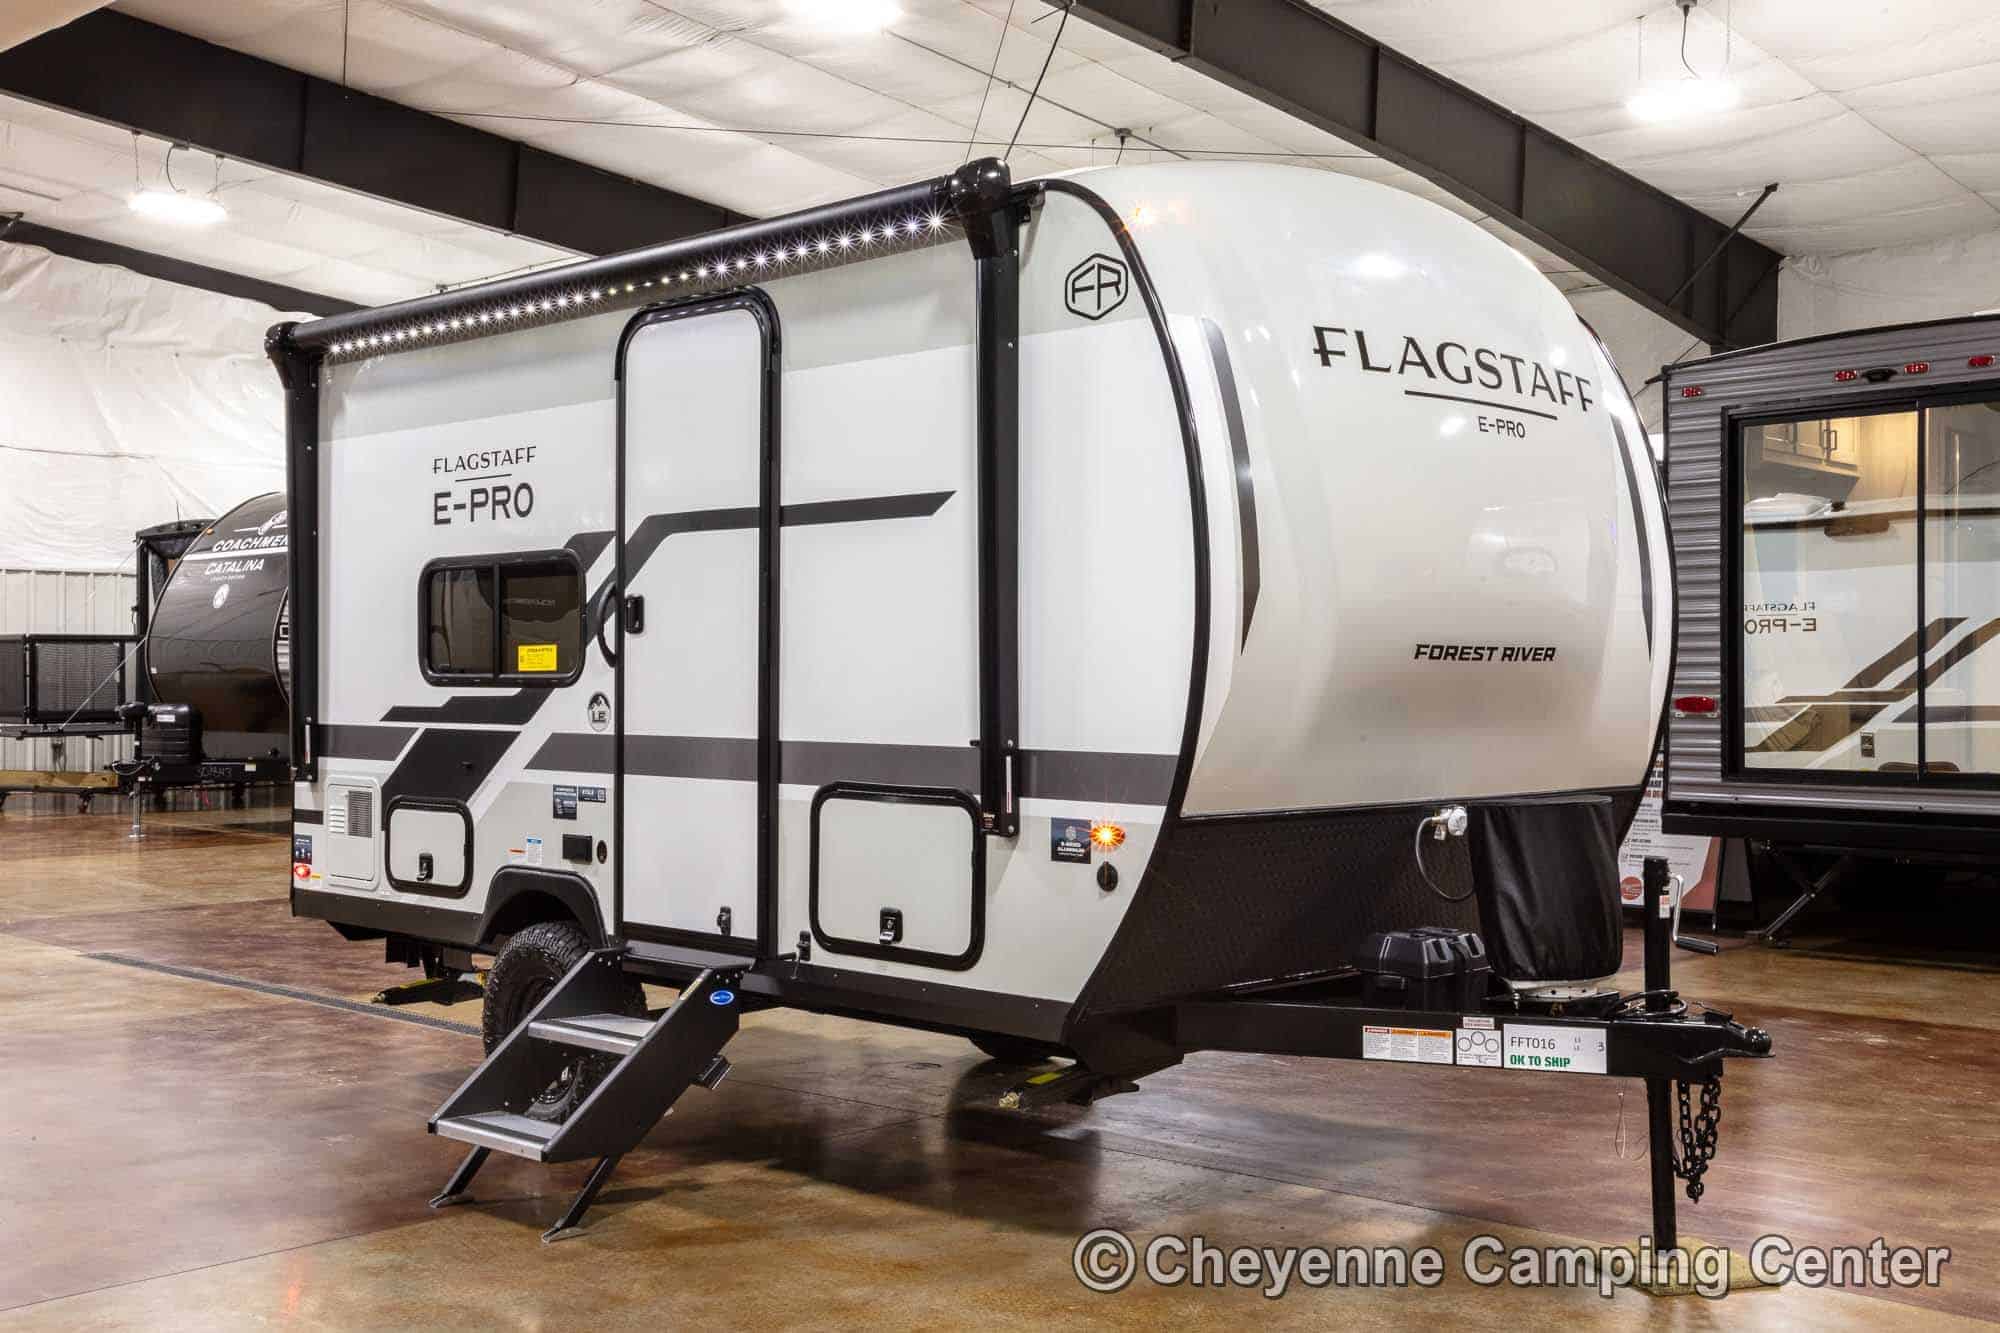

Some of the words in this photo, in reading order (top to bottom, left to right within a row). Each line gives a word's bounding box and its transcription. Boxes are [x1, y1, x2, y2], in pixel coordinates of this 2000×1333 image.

[1312, 325, 1593, 412] FLAGSTAFF
[1478, 415, 1526, 439] E-PRO
[431, 445, 537, 475] FLAGSTAFF
[433, 482, 534, 526] E-PRO
[205, 558, 265, 575] CATALINA
[1414, 643, 1499, 662] FOREST
[1501, 646, 1556, 662] RIVER
[1510, 1036, 1556, 1050] FFT016
[1510, 1054, 1526, 1065] OK
[1528, 1055, 1542, 1066] TO
[1544, 1056, 1571, 1068] SHIP
